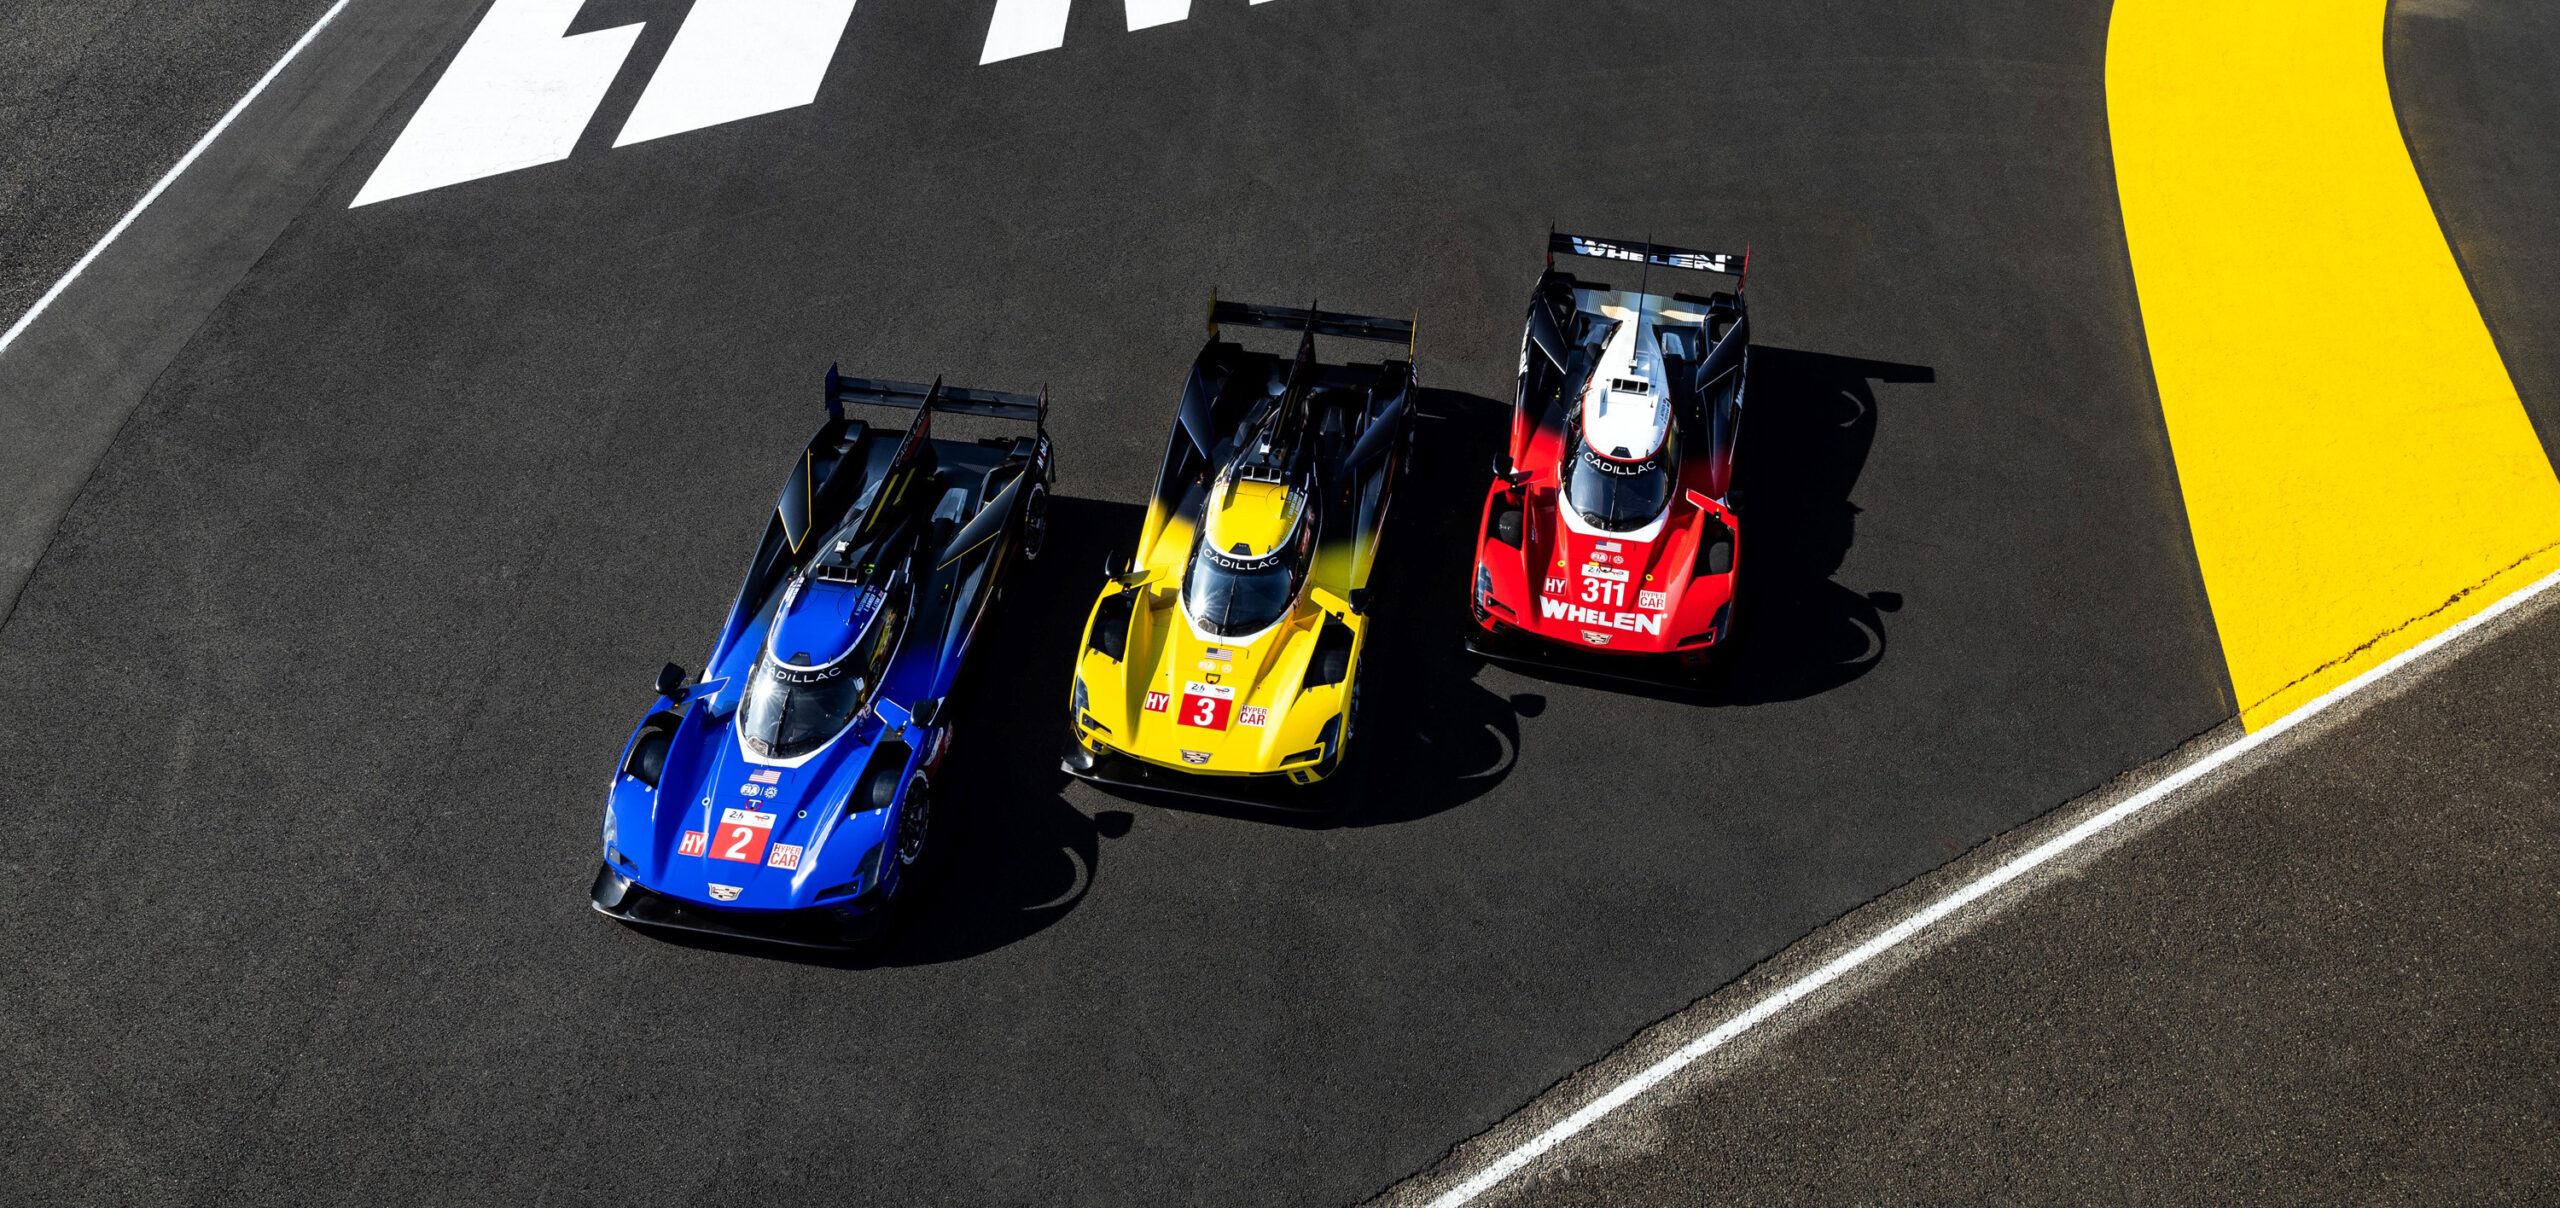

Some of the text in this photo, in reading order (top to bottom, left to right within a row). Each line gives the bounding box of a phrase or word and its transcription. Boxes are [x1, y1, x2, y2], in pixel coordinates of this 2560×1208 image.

[1572, 236, 1725, 272] WHELEN
[1584, 452, 1656, 475] CADILLAC
[1203, 548, 1279, 570] CADILLAC
[1545, 578, 1566, 593] HY
[1581, 578, 1625, 607] 311
[1640, 597, 1664, 608] CAR
[1641, 591, 1665, 600] HYPER
[1539, 595, 1662, 635] WHELEN
[1145, 693, 1169, 710] HY
[1241, 704, 1267, 715] HYPER
[1193, 698, 1216, 726] 3
[1239, 712, 1266, 726] CAR
[680, 833, 706, 854] HY
[724, 827, 753, 860] 2
[773, 844, 801, 855] HYPER
[770, 852, 799, 868] CAR
